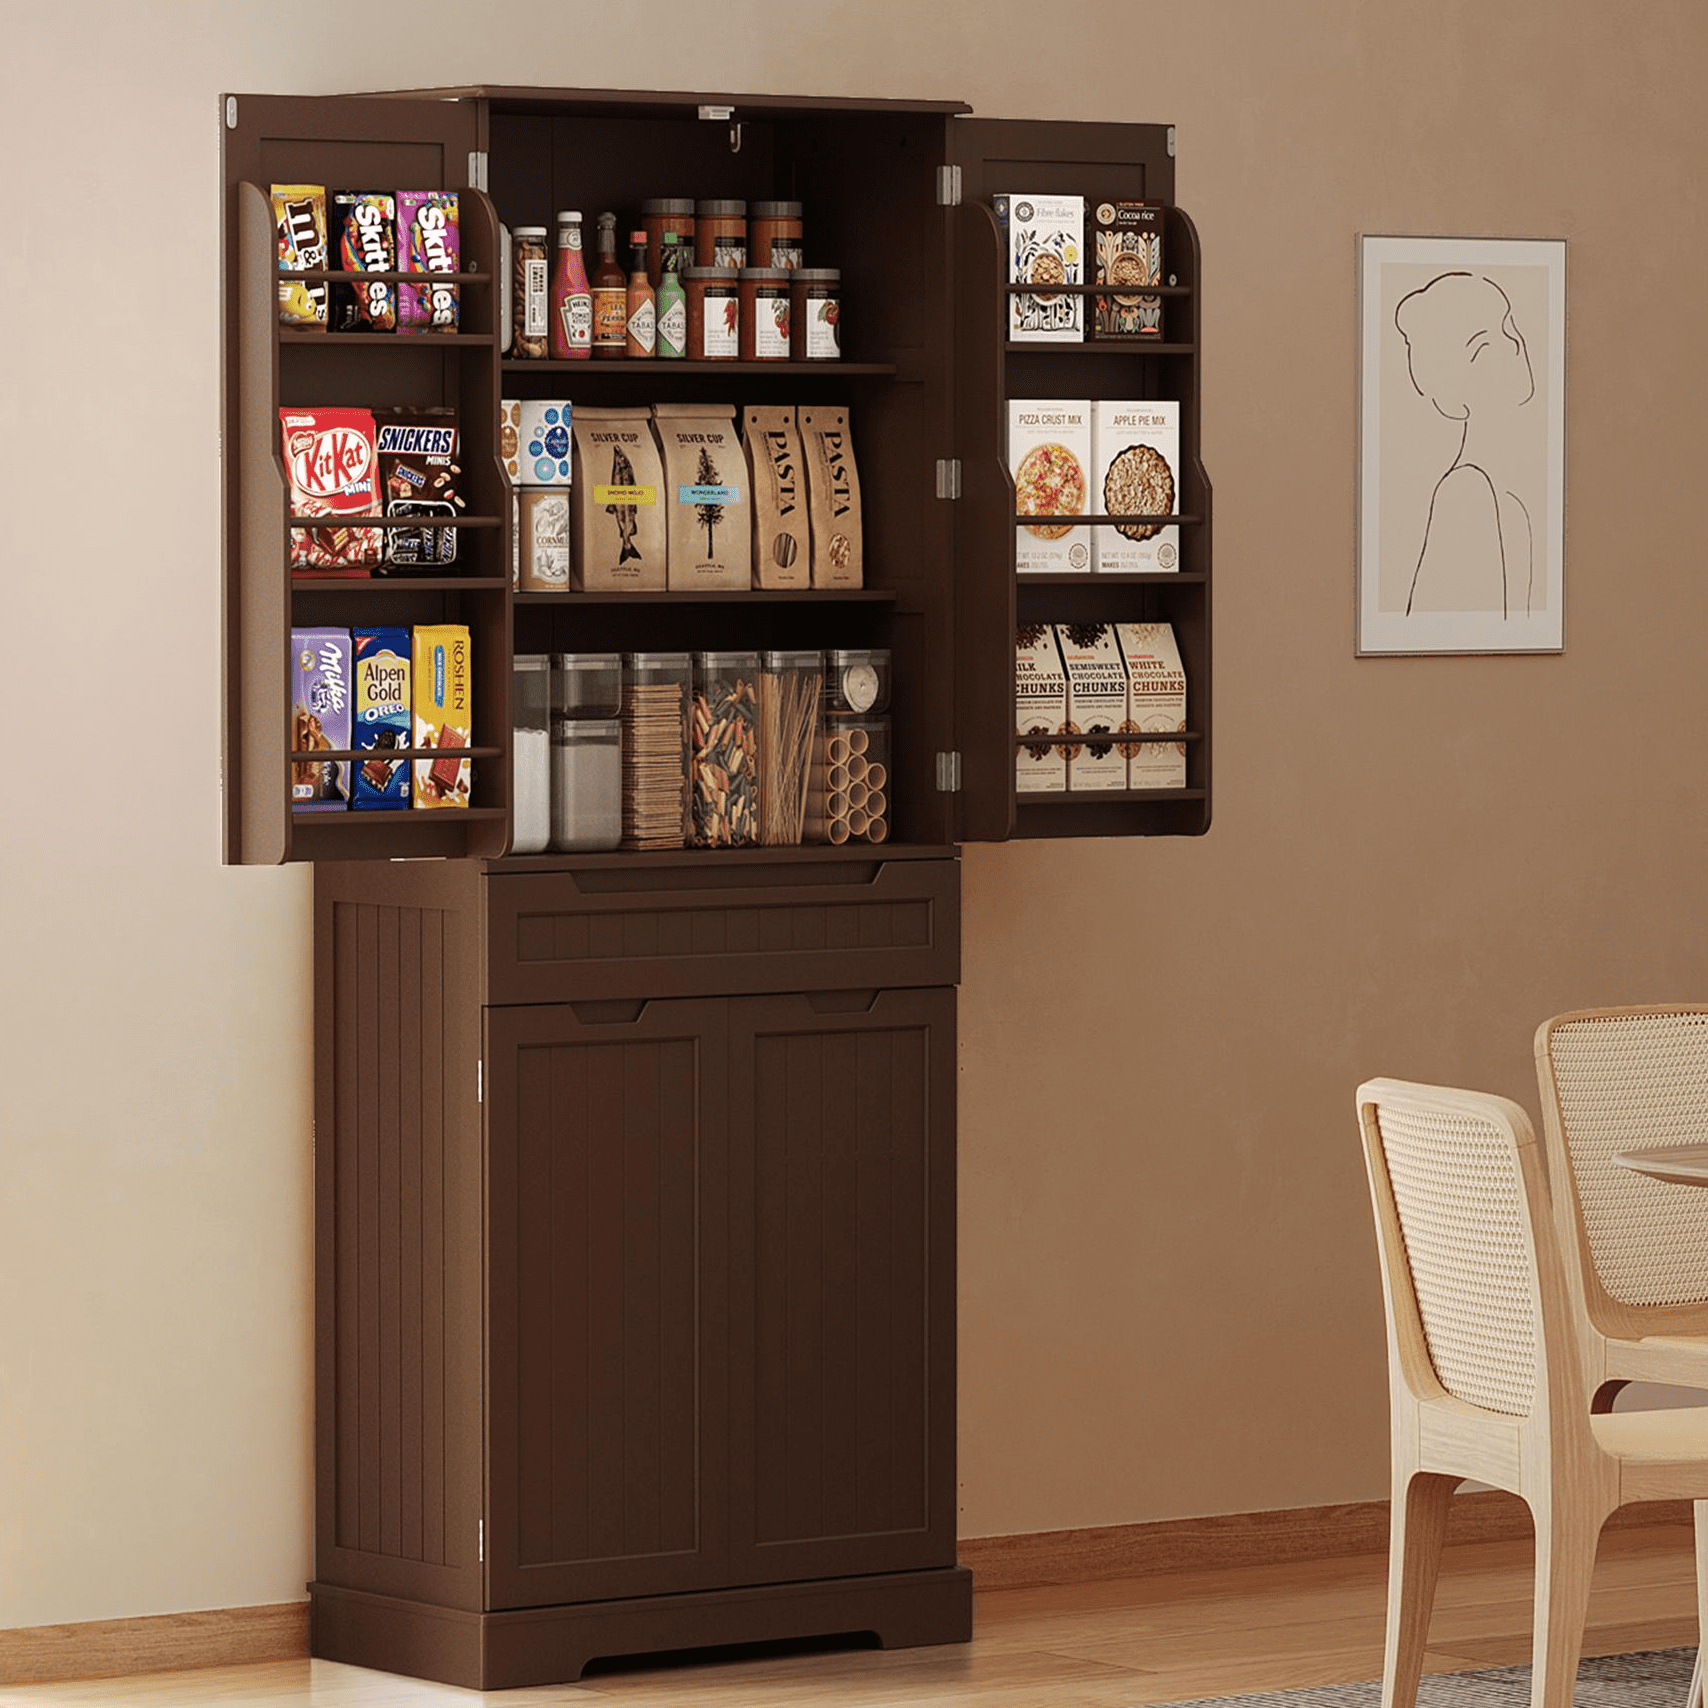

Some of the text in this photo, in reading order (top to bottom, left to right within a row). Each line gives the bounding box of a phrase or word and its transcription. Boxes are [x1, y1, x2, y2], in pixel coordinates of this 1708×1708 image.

[1118, 210, 1155, 220] Cocoa rice
[356, 205, 390, 317] Skittes
[1019, 414, 1082, 425] PIZZA CRUST MIX
[1113, 415, 1165, 426] APPLE PIE MIX
[379, 428, 452, 453] SNICKERS
[591, 433, 639, 443] SILVER CUP
[677, 434, 725, 443] SILVER CUP
[426, 456, 451, 466] MINIS
[768, 431, 796, 517] PASTA
[824, 431, 851, 518] PASTA
[1016, 662, 1036, 671] ILK
[1069, 662, 1121, 671] SEMISWEET
[1129, 661, 1165, 670] WHITE
[319, 642, 347, 715] Milka
[364, 662, 405, 686] Alpen
[453, 640, 465, 711] ROSHEN
[1016, 673, 1063, 681] HOCOLATE
[1071, 672, 1124, 681] CHOCOLATE
[1131, 671, 1184, 680] CHOCOLATE
[367, 682, 402, 701] Gold
[1073, 682, 1125, 693] CHUNKS
[1133, 681, 1185, 692] CHUNKS
[364, 703, 405, 721] OREO
